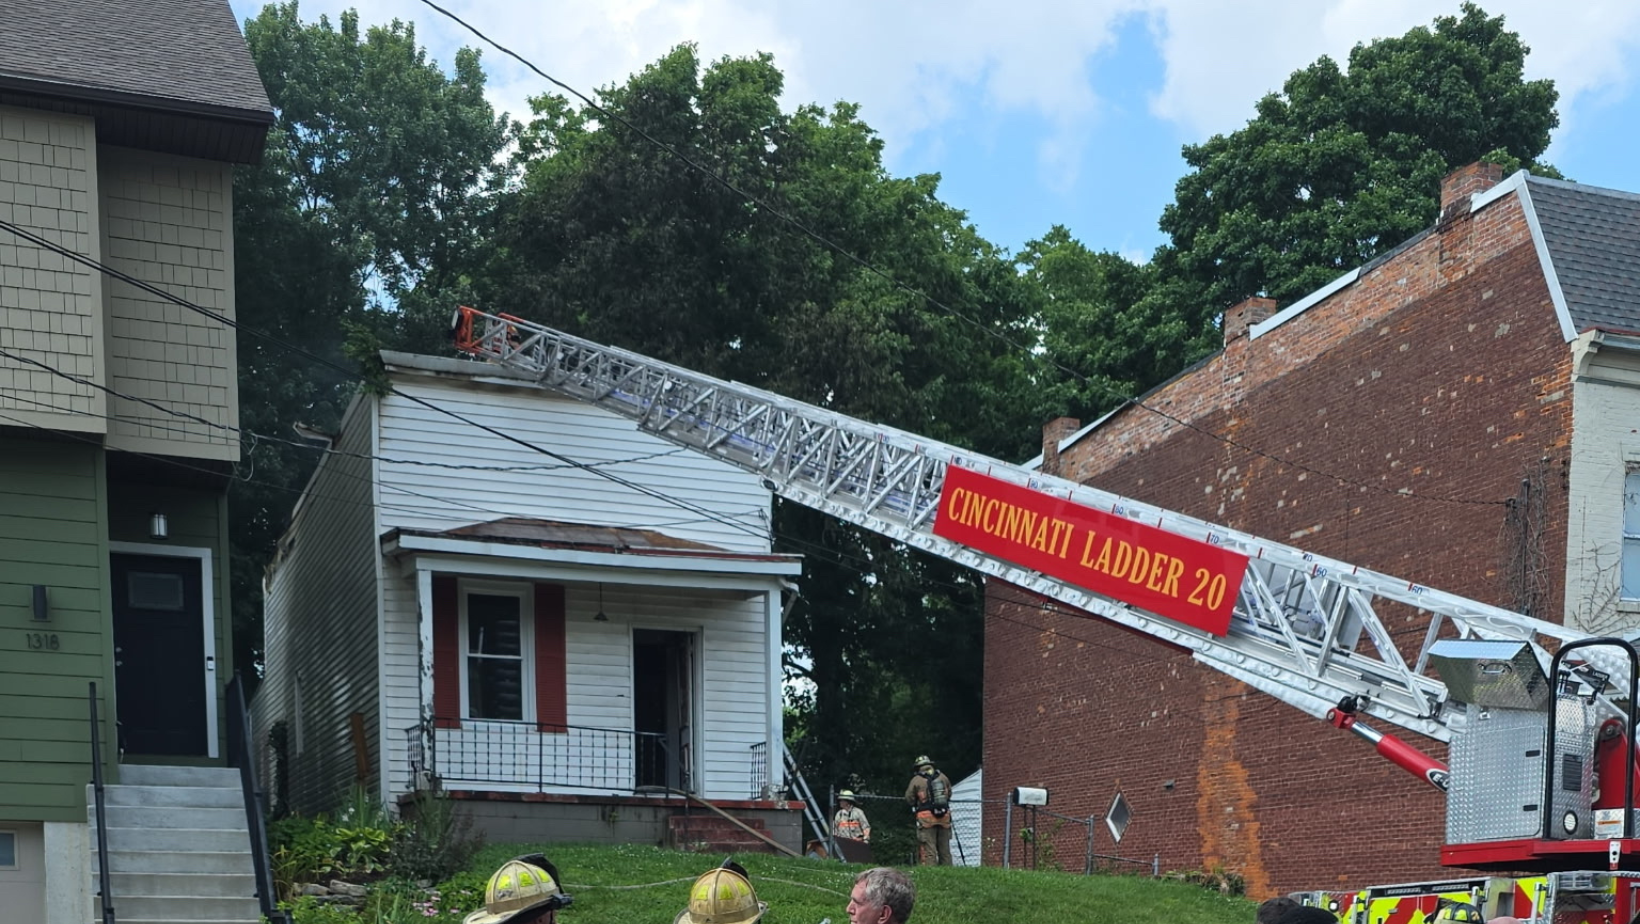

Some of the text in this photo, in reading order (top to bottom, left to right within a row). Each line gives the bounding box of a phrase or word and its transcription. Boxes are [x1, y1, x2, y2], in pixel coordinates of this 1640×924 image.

[1210, 534, 1220, 544] 70
[948, 487, 1227, 611] CINCINNATI LADDER 20
[1316, 567, 1327, 577] 60
[25, 633, 60, 651] 1318
